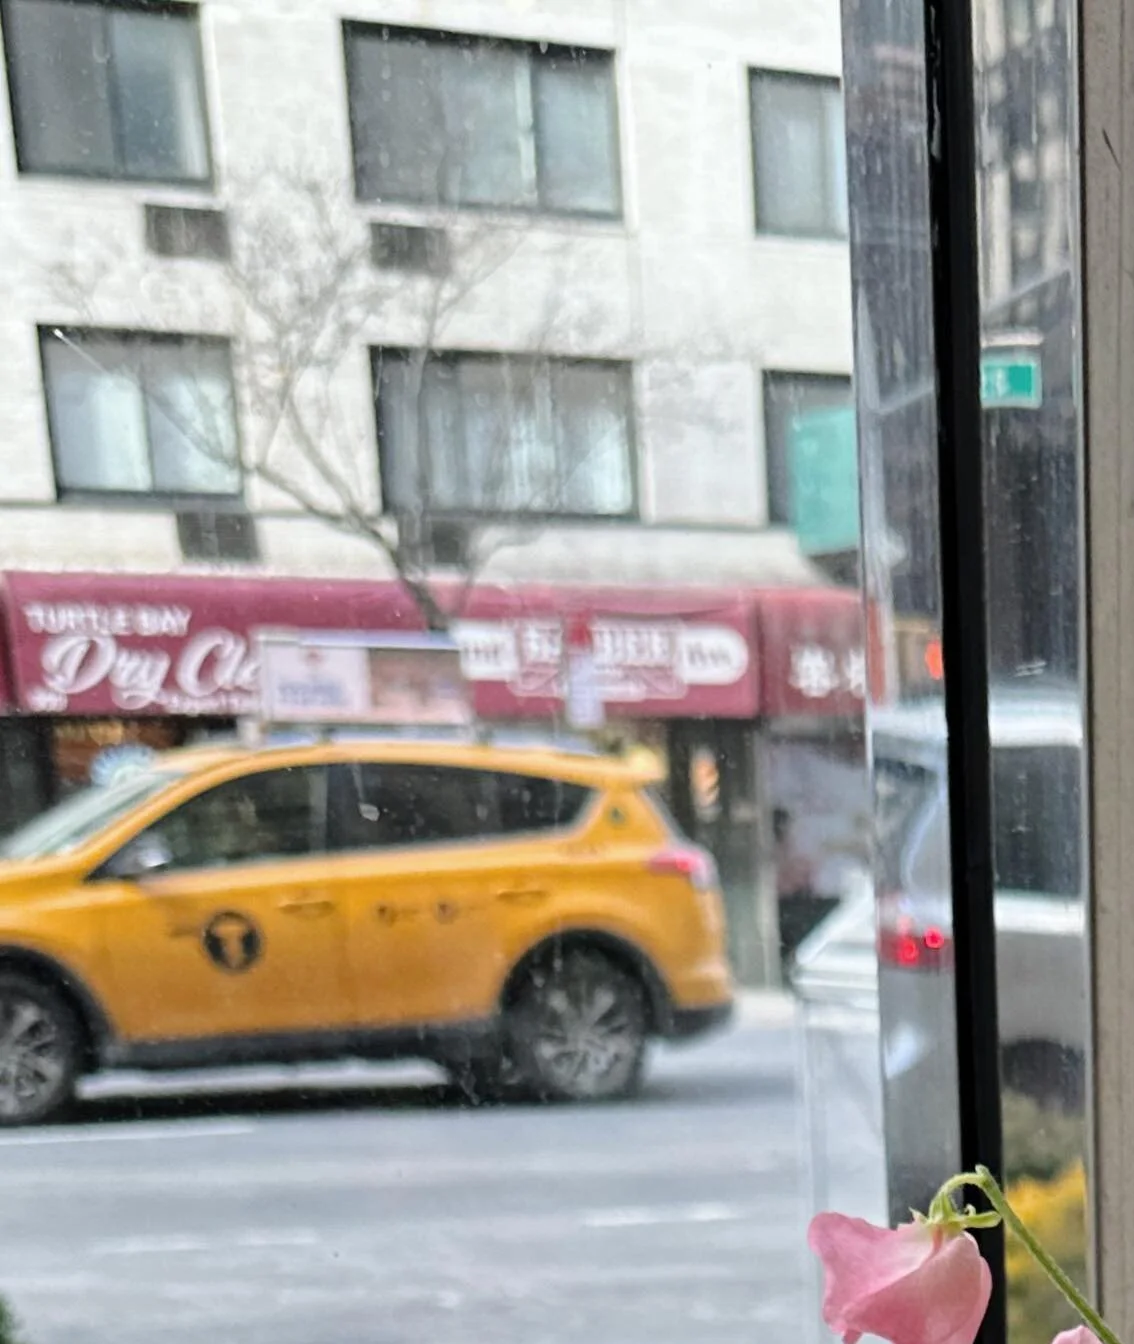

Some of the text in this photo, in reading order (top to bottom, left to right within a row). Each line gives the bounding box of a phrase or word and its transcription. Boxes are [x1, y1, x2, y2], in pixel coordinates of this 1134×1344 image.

[23, 603, 192, 636] TURTLE BAY
[41, 633, 171, 710] Dry
